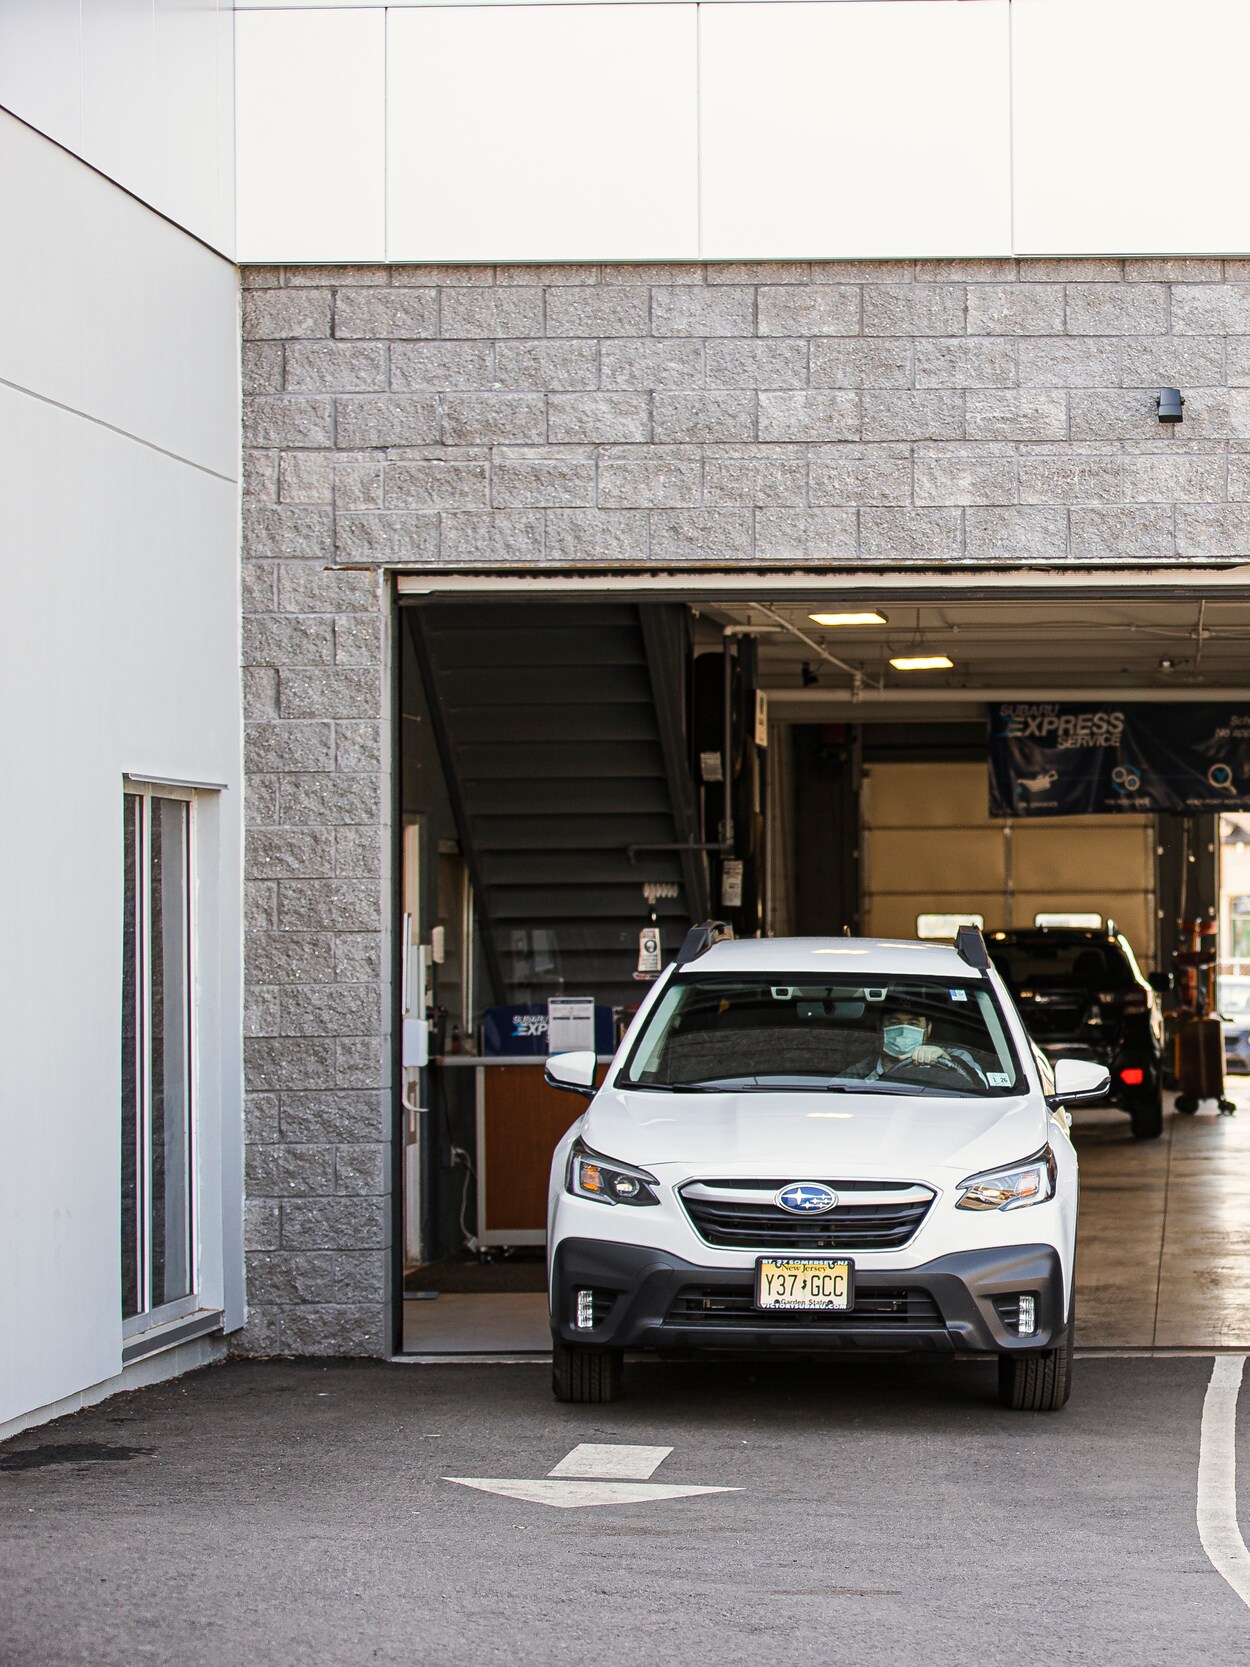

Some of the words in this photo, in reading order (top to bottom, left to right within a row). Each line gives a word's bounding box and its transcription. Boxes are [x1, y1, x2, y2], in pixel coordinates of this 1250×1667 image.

[1000, 704, 1059, 717] SUBARU
[1000, 712, 1125, 737] EXPRESS
[1057, 734, 1121, 749] SERVICE
[512, 1015, 549, 1024] SUBAR
[802, 1264, 827, 1273] Jersey
[765, 1274, 798, 1296] Y37
[811, 1275, 844, 1297] GCC
